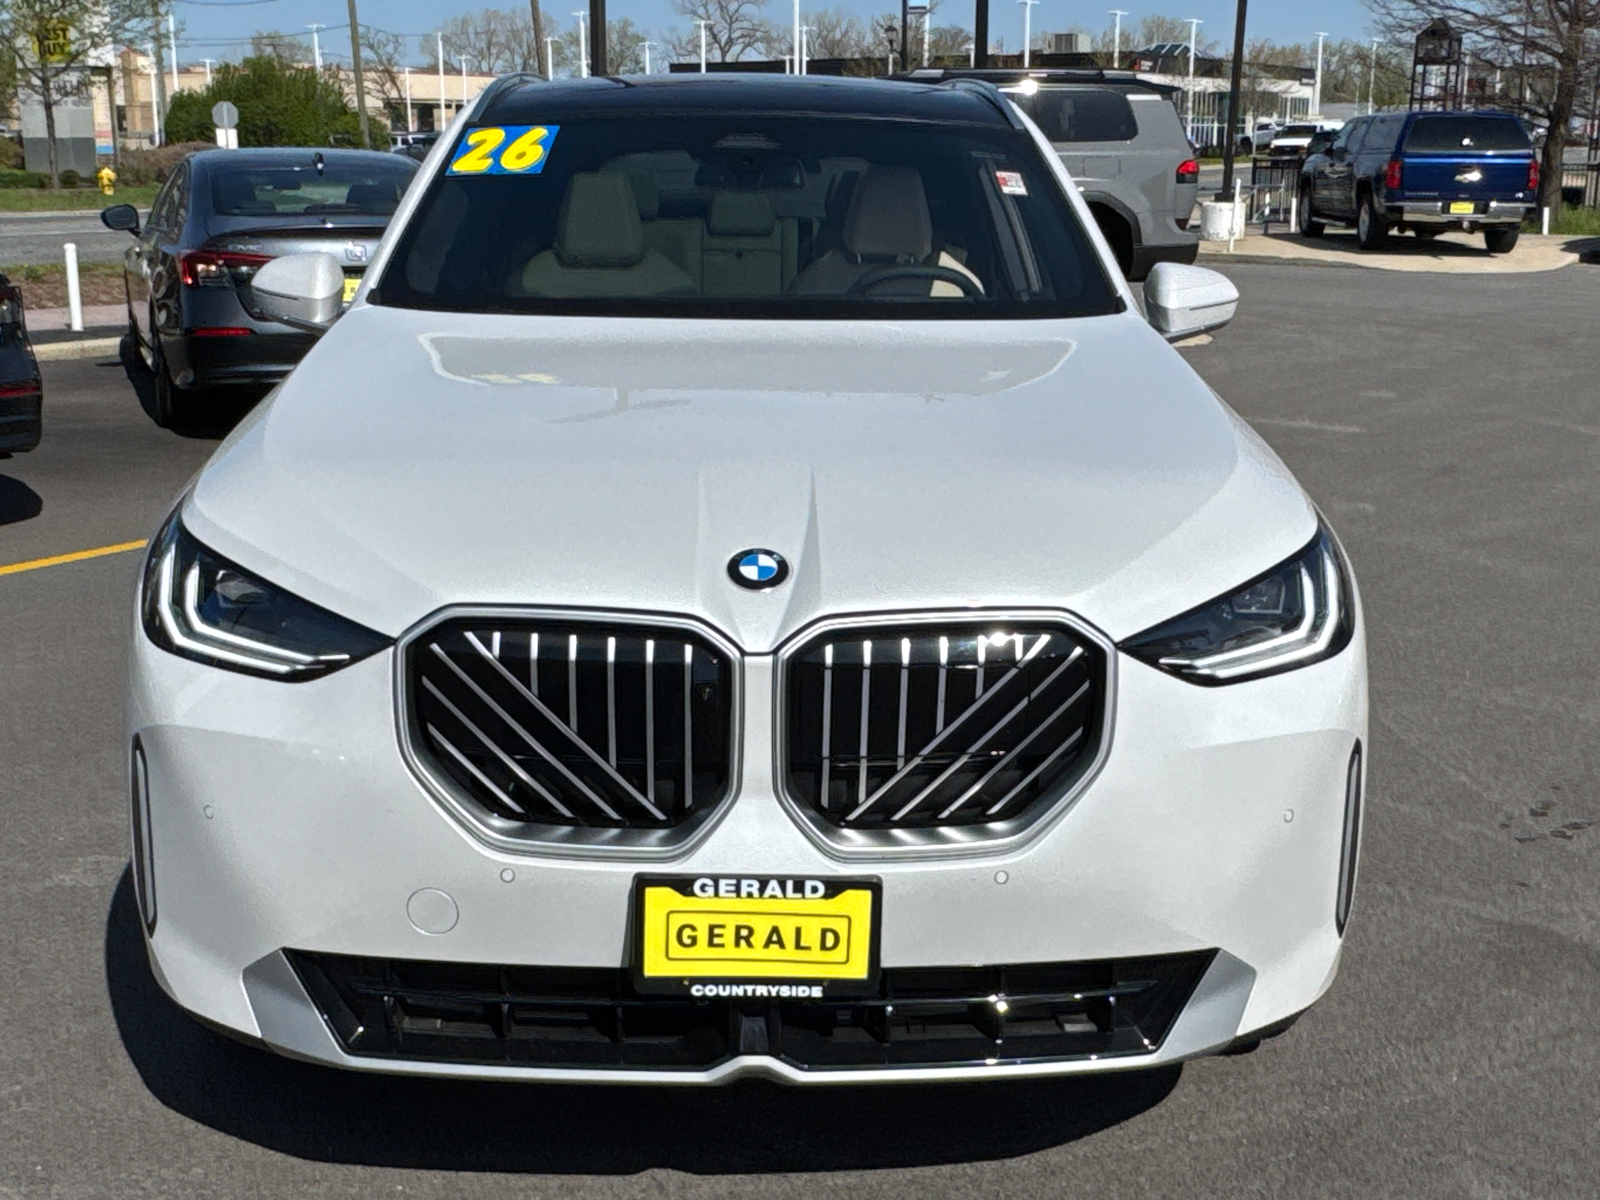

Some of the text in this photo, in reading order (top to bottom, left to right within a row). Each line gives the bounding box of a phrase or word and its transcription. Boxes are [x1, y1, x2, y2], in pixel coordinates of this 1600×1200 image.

[452, 127, 548, 172] 26
[692, 878, 826, 900] GERALD
[676, 923, 841, 952] GERALD
[690, 984, 824, 998] COUNTRYSIDE
